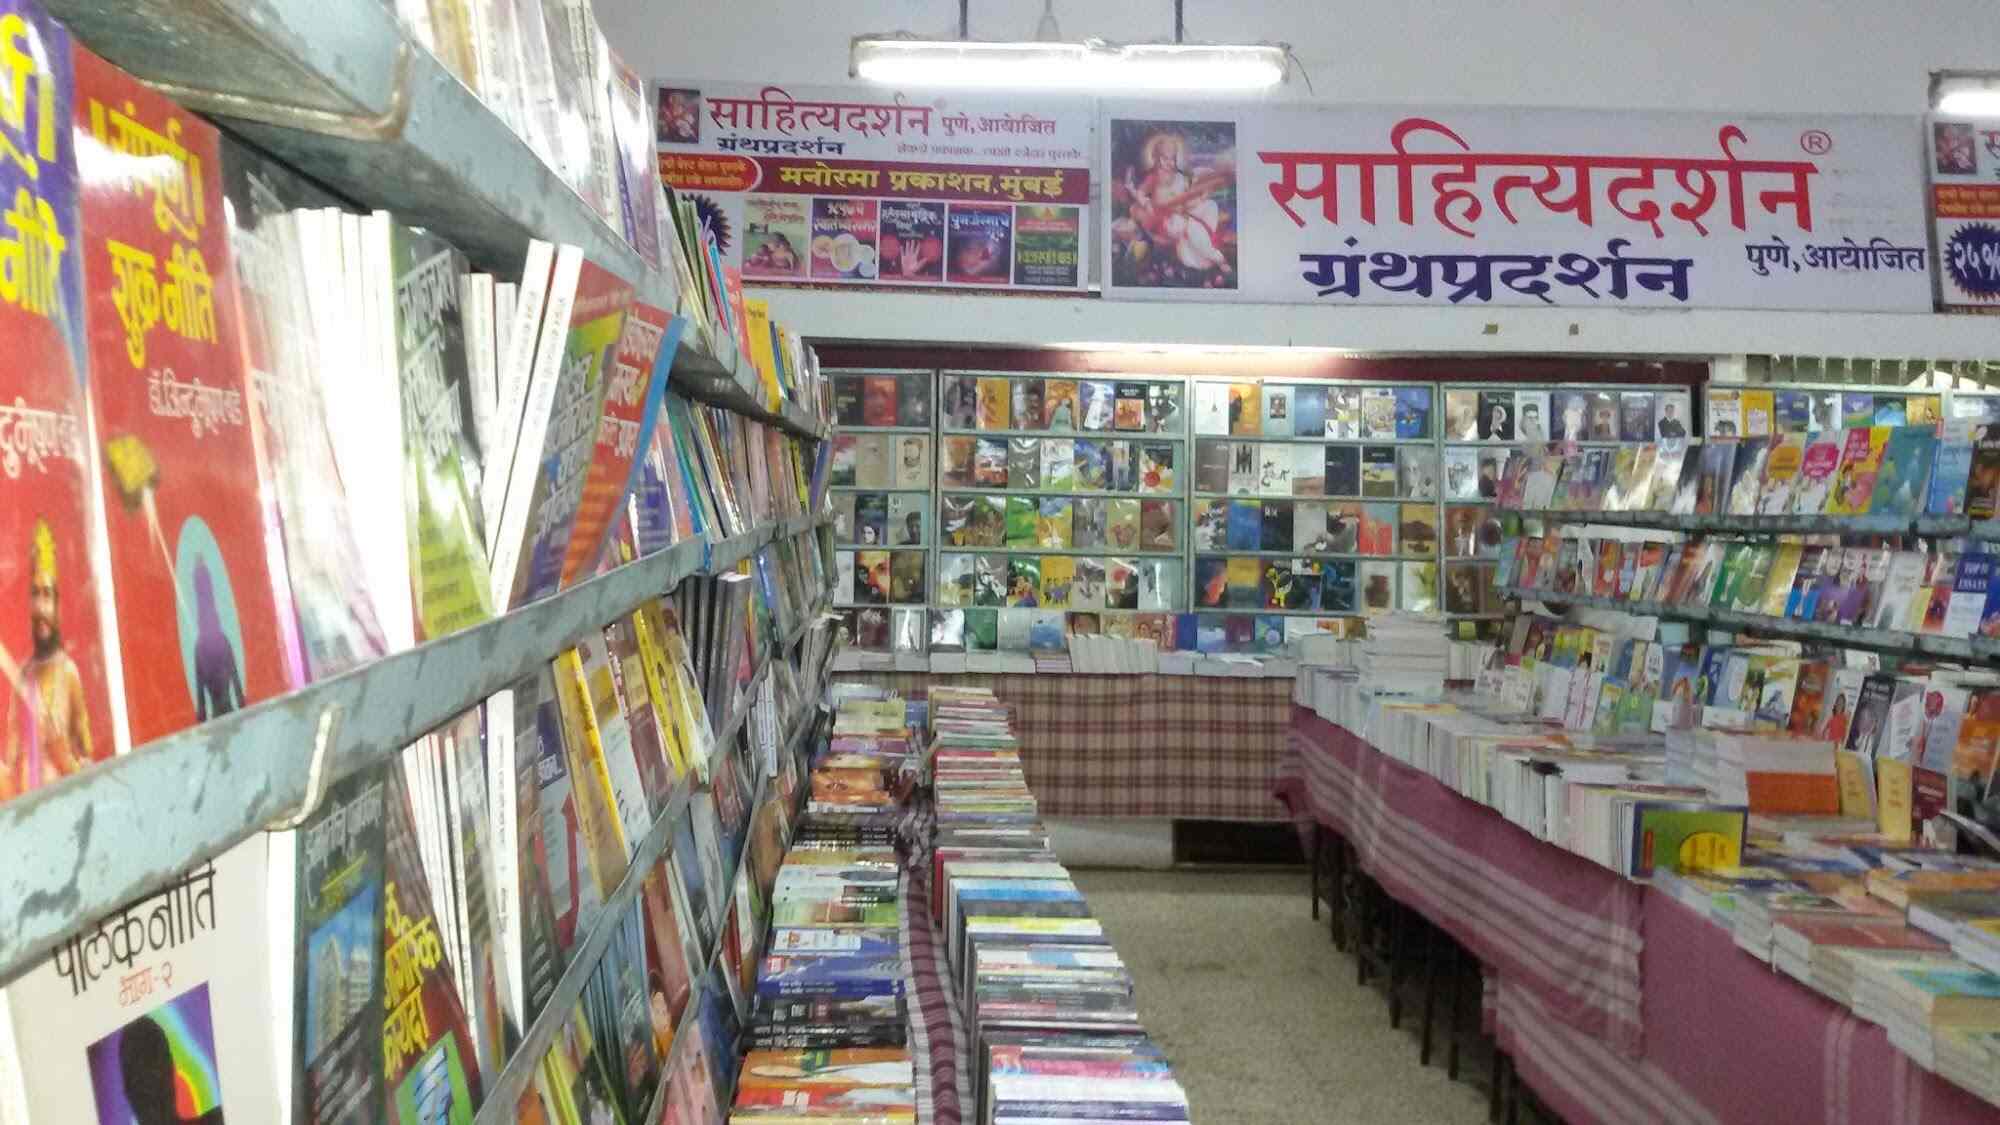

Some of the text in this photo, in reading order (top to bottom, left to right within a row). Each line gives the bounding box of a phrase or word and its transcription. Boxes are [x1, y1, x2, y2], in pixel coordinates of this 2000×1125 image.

[706, 86, 933, 138] साहित्यदर्शन
[717, 132, 846, 156] ग्रंथप्रदर्शन
[779, 161, 880, 188] मनोरमा
[1257, 117, 1819, 238] साहित्यदर्शन
[1300, 236, 1693, 304] ग्रंथप्रदर्शन
